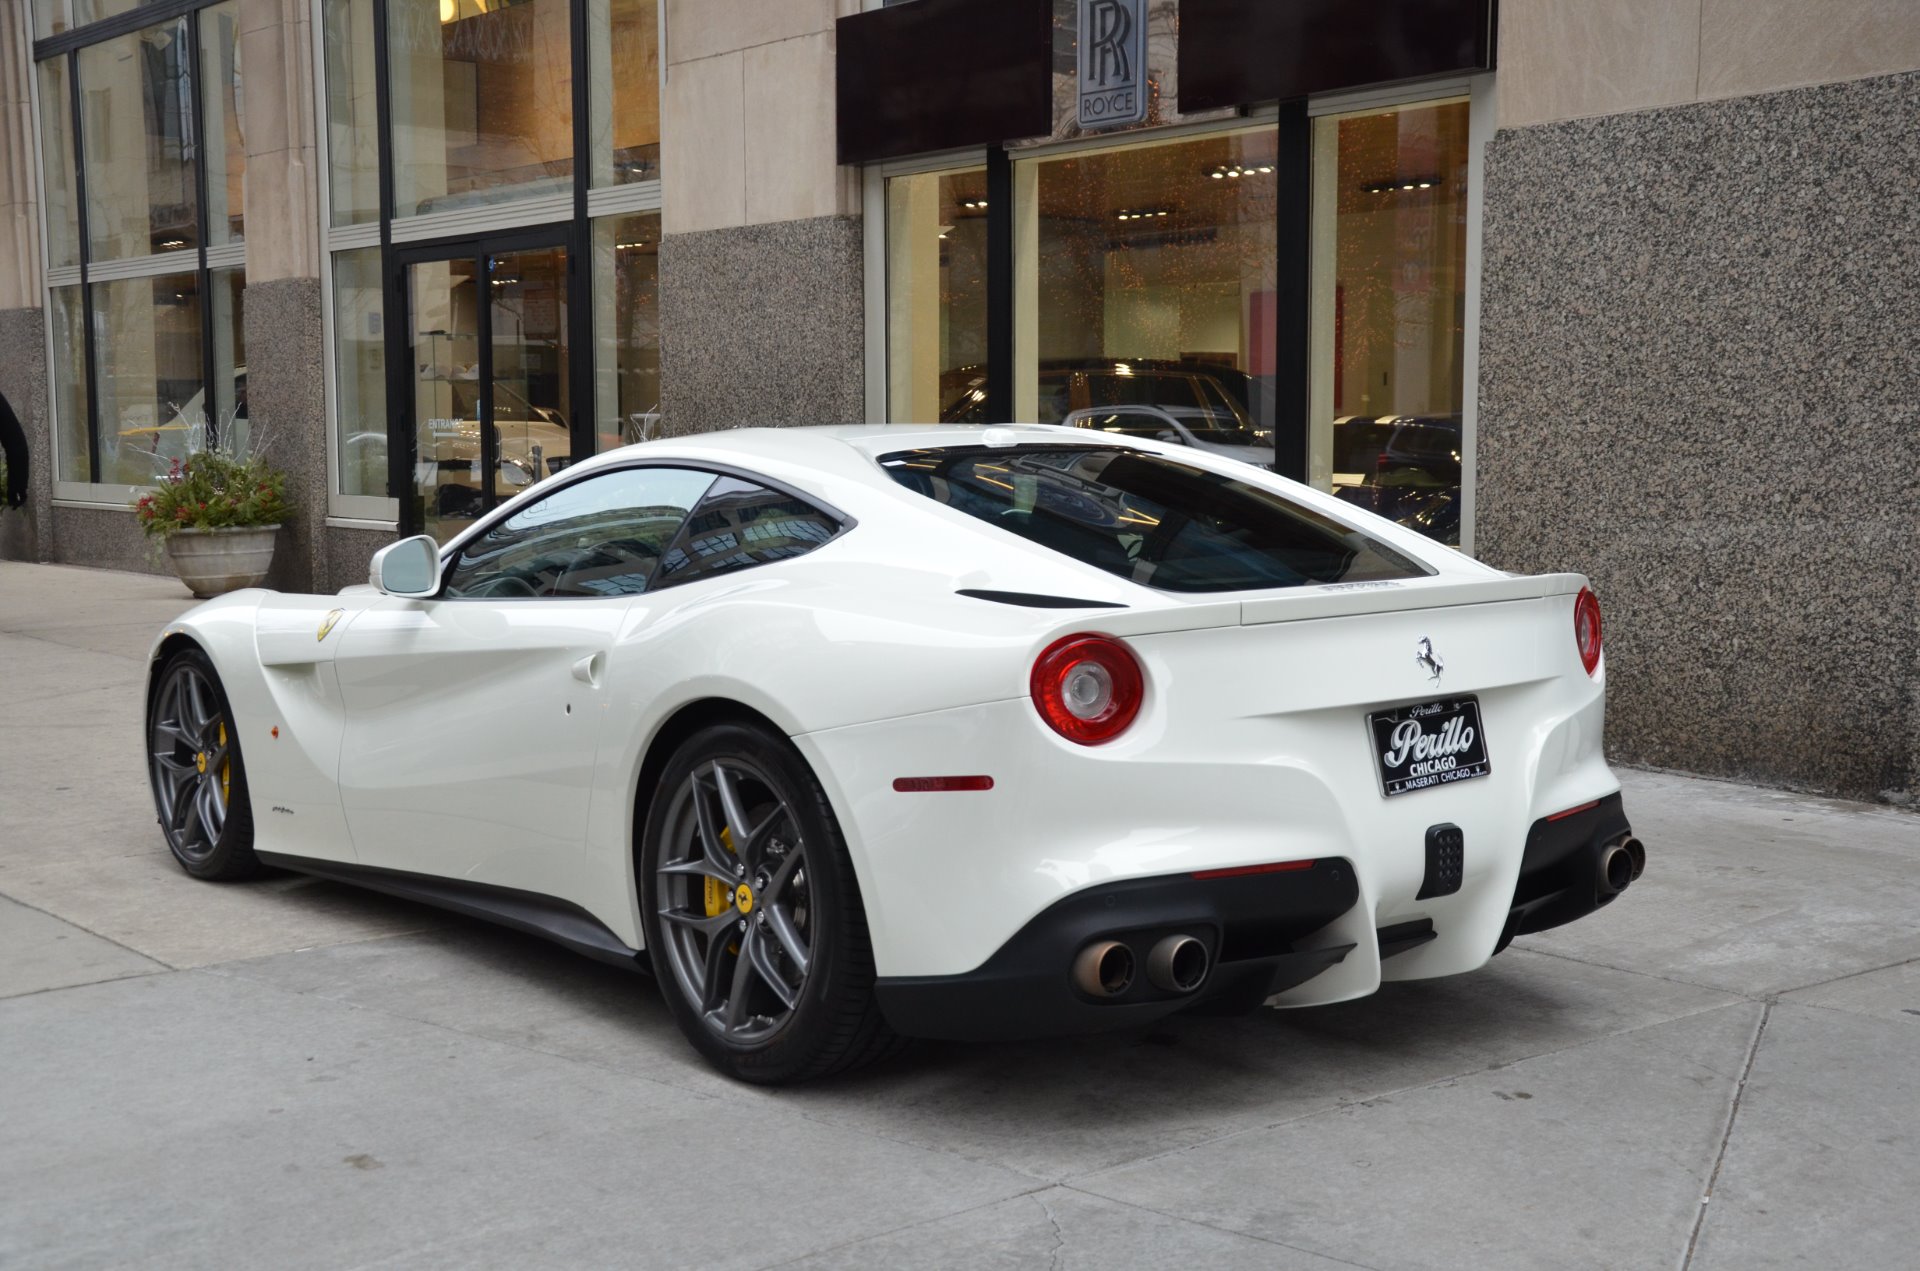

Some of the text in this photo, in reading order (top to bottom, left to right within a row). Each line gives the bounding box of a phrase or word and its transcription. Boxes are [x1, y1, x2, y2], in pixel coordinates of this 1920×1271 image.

[1084, 92, 1132, 117] ROYCE
[1409, 703, 1443, 718] Perillo
[1384, 716, 1474, 767] Perillo
[1410, 756, 1456, 776] CHICAGO
[1405, 775, 1439, 790] MASERATI
[1441, 768, 1471, 782] CHICAGO
